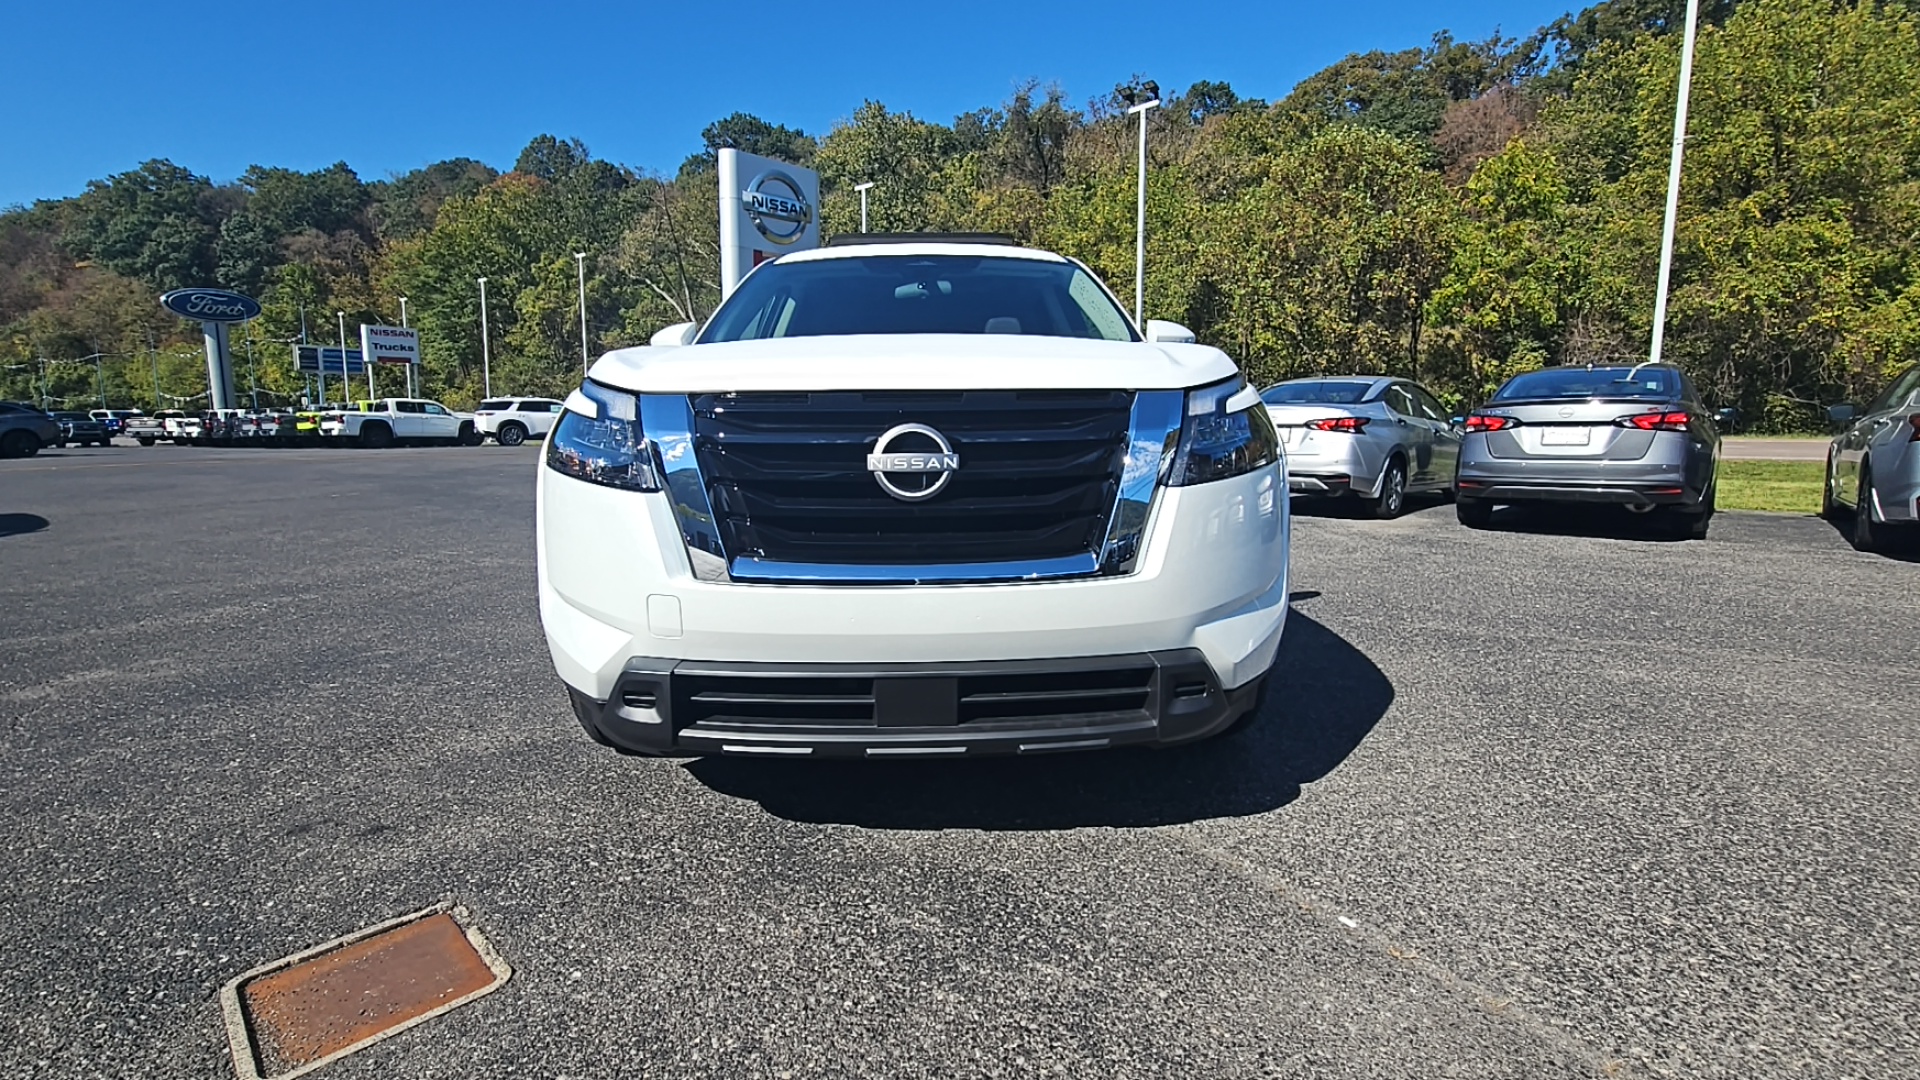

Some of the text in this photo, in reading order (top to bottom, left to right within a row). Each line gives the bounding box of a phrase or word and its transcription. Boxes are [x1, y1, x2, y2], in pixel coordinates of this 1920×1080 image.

[752, 195, 807, 218] NISSAN
[186, 293, 243, 315] Ford
[370, 328, 414, 338] NISSAN
[371, 342, 414, 352] Trucks
[870, 456, 957, 469] NISSAN
